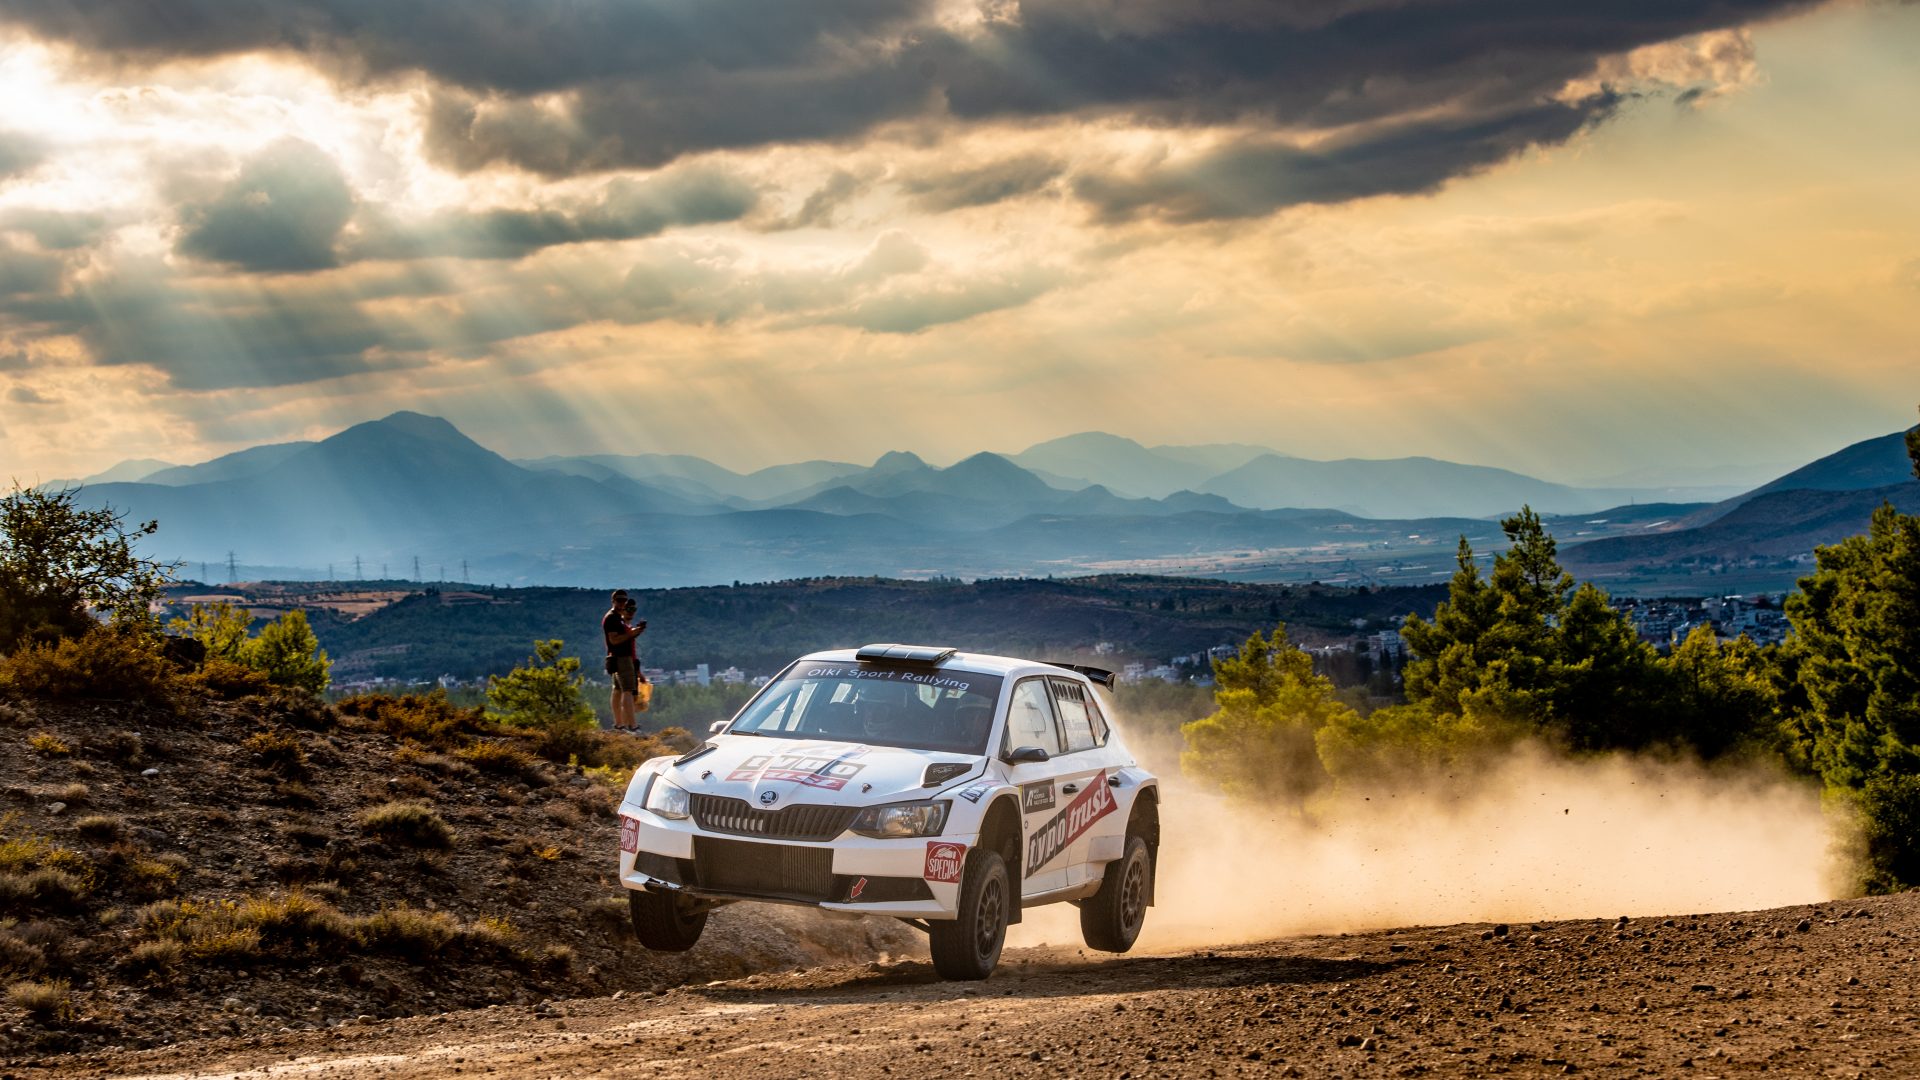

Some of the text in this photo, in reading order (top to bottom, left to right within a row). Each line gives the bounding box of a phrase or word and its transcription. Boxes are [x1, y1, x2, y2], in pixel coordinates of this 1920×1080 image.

[807, 668, 970, 690] Olki Sport Rallying
[929, 858, 960, 880] SPECIAL
